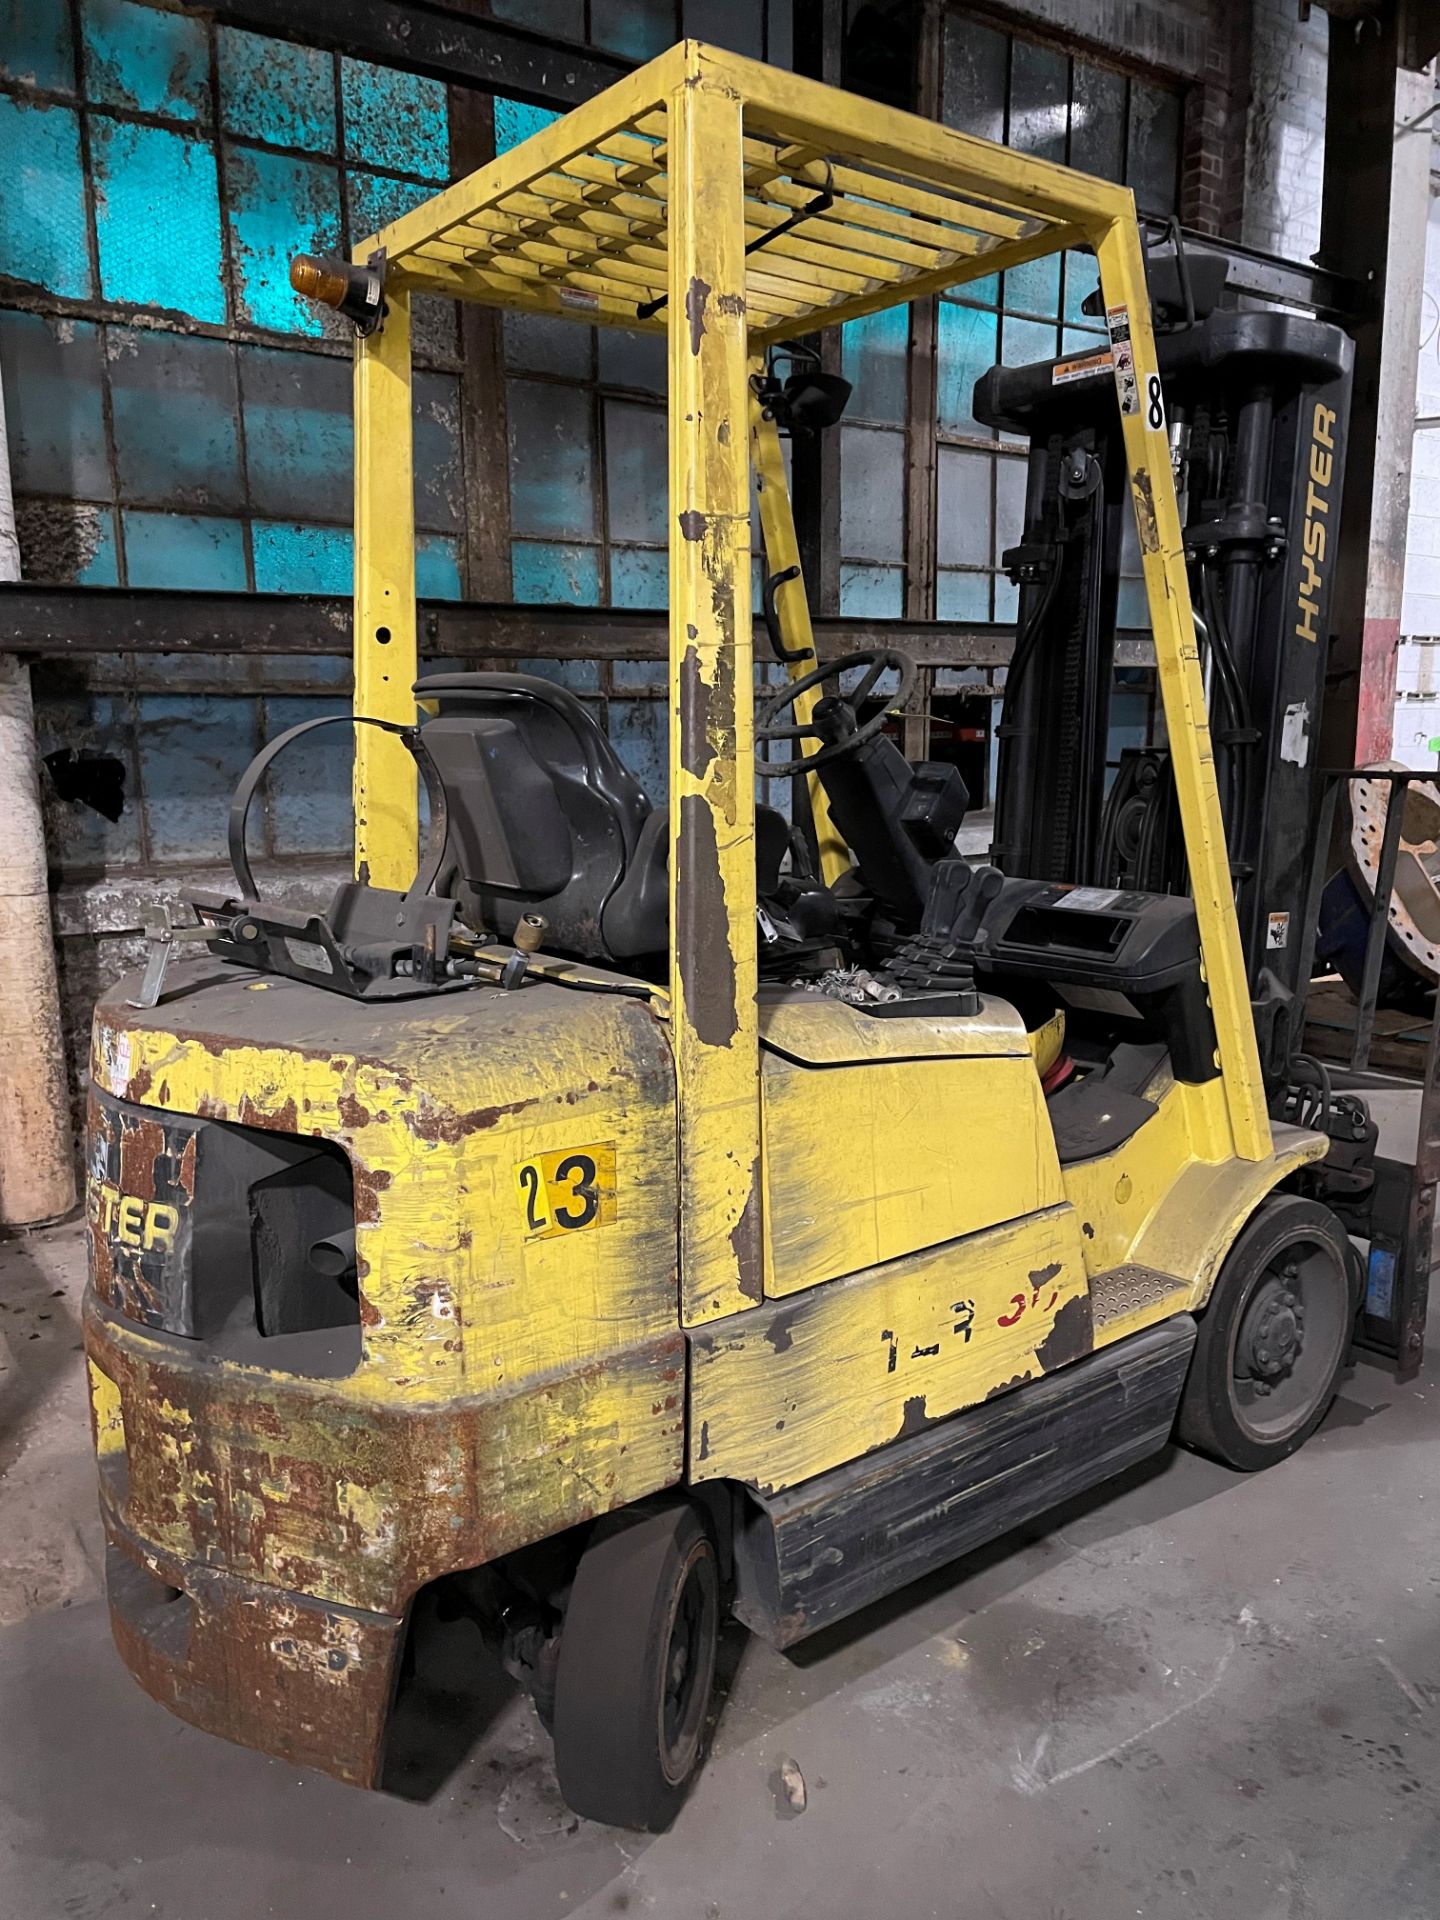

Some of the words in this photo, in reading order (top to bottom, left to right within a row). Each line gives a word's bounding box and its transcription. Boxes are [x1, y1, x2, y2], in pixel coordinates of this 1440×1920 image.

[1149, 376, 1162, 429] 8
[1296, 403, 1336, 643] HYSTER
[520, 1154, 599, 1230] 23
